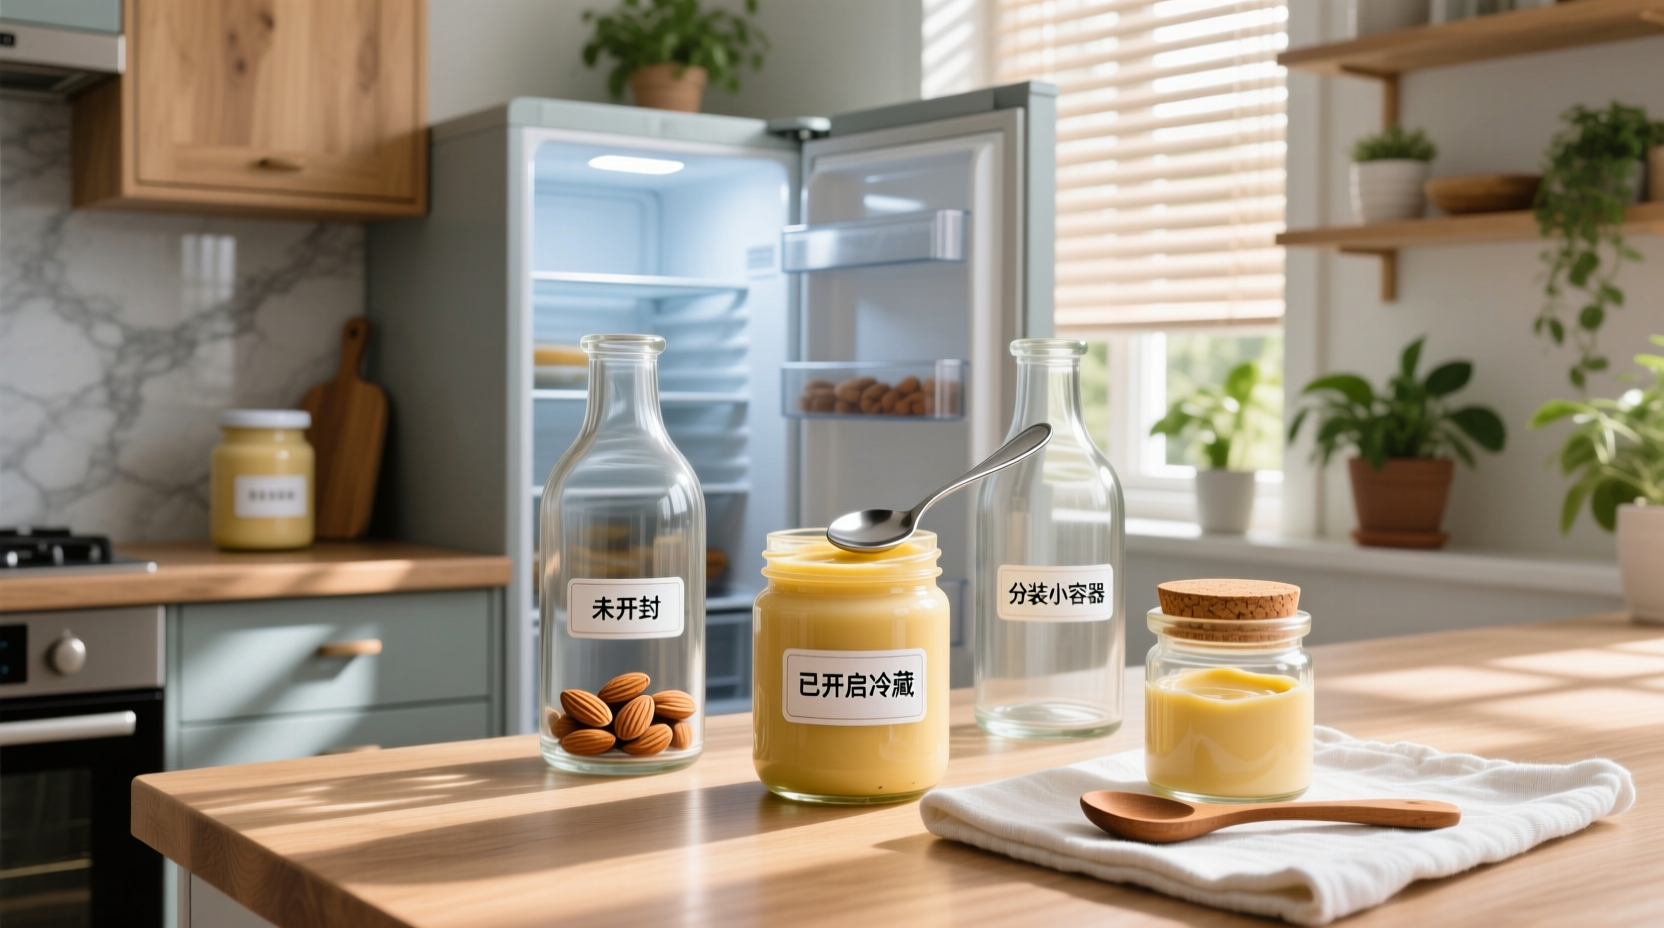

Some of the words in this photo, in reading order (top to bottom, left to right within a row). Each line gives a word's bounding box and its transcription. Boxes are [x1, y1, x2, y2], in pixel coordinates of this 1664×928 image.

[1008, 581, 1105, 606] 分装小容器
[592, 595, 661, 621] 未开封
[799, 670, 915, 699] 已开启冷藏
